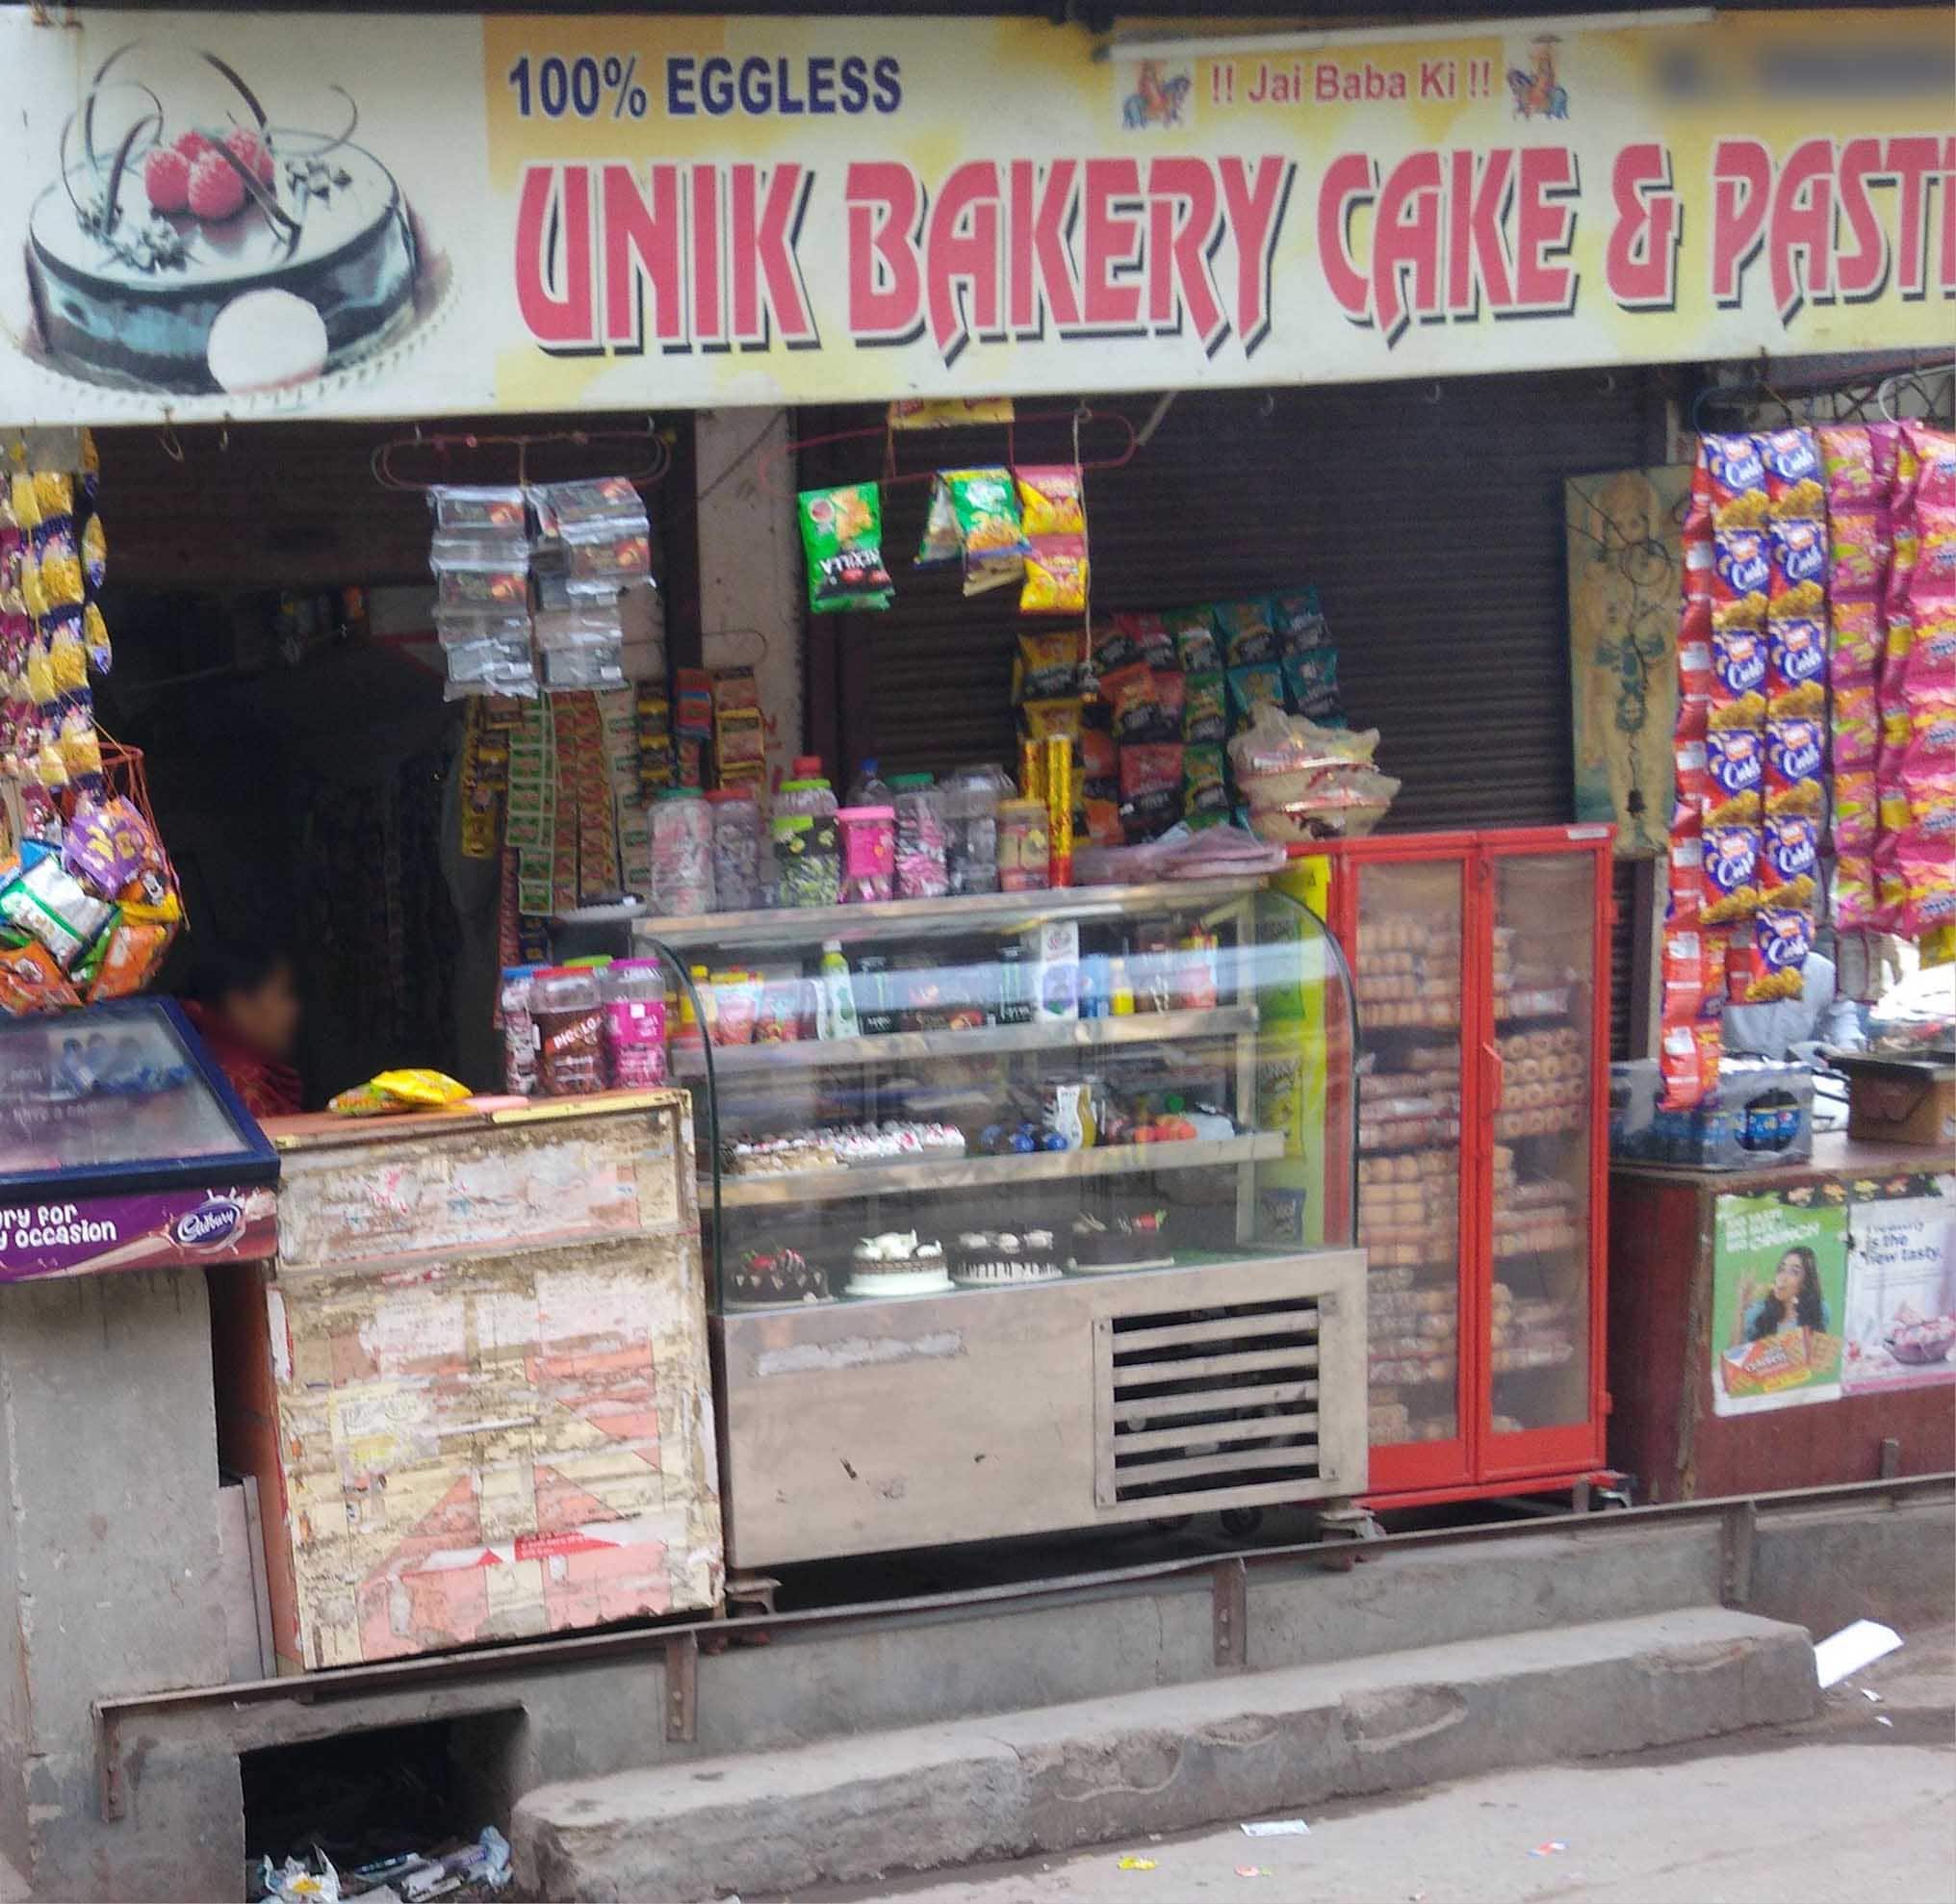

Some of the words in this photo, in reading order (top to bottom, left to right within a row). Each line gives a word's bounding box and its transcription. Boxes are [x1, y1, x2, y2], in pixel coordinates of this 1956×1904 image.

[509, 56, 648, 117] 100%
[665, 55, 902, 116] EGGLESS
[1248, 64, 1300, 103] Jai
[1315, 63, 1406, 101] Baba
[1420, 61, 1455, 98] Ki
[513, 162, 822, 357] UNIK
[845, 155, 1298, 369] BAKERY
[1317, 144, 1581, 350] CAKE
[1606, 142, 1684, 313] &
[1711, 136, 1956, 330] PAST
[38, 1202, 78, 1227] for
[177, 1210, 235, 1243] Cadbury
[14, 1219, 117, 1249] occasion
